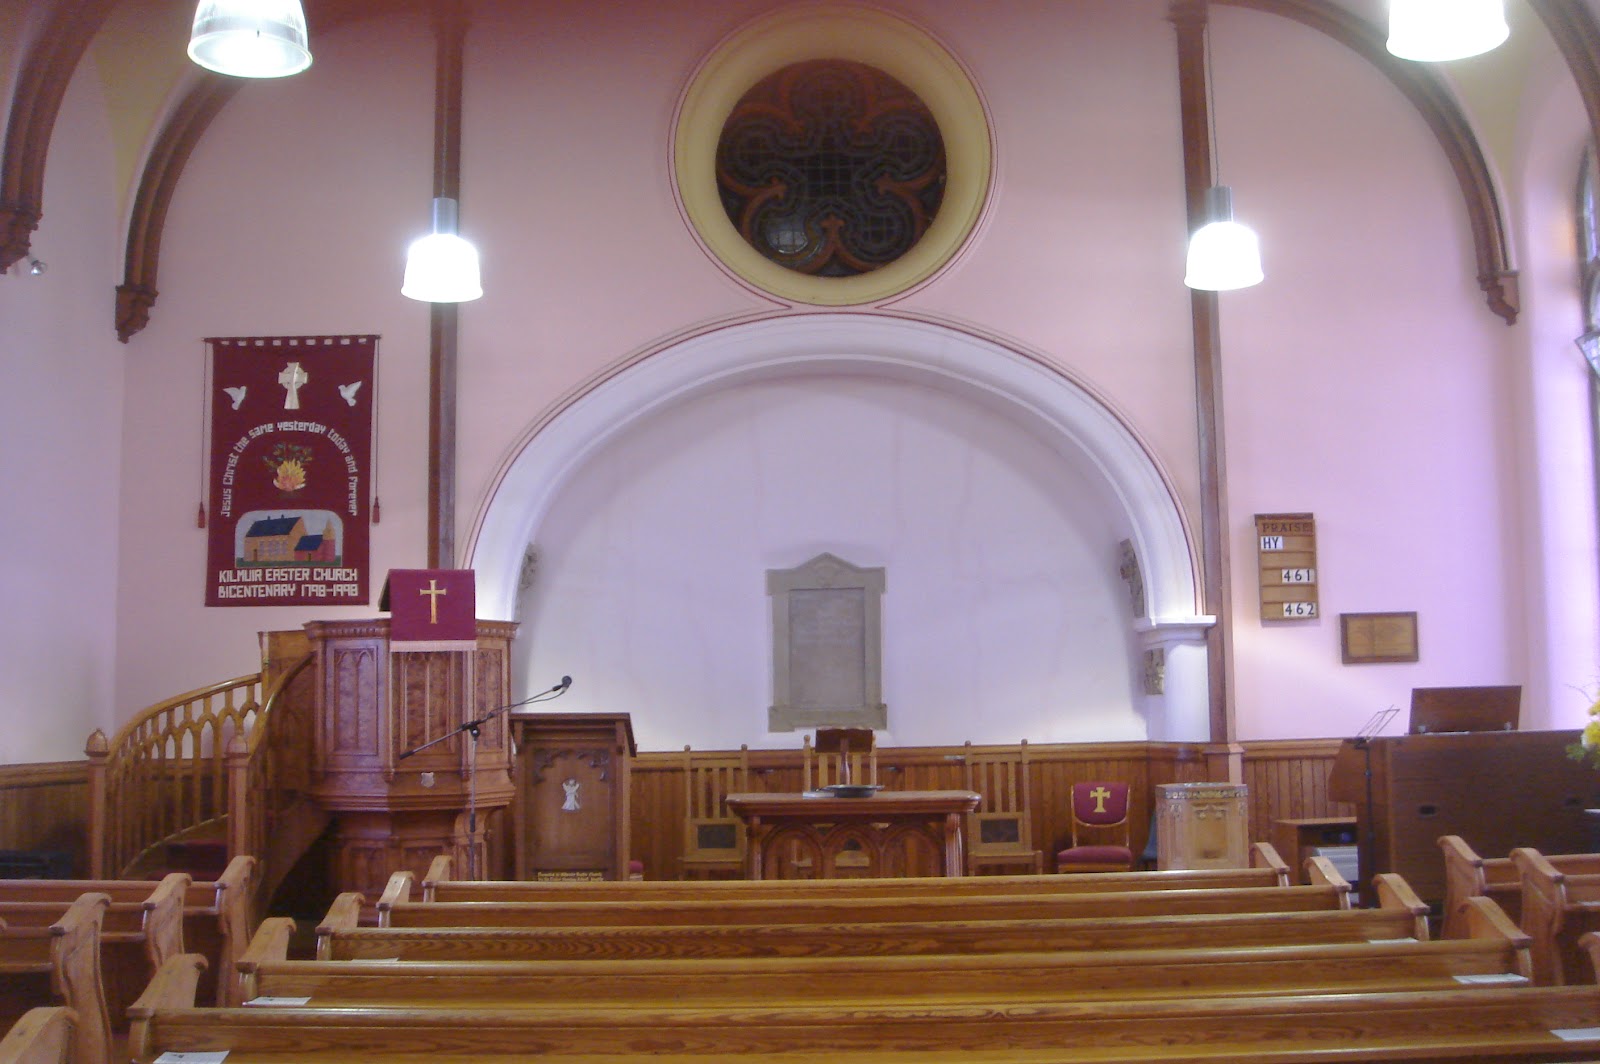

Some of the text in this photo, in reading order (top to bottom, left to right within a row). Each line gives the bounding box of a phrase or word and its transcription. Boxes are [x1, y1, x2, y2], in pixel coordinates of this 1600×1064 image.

[1263, 537, 1279, 549] HY
[219, 568, 357, 583] KILMUIR EASTER CHURCH
[1283, 570, 1311, 581] 461
[218, 583, 359, 598] BICENTENARY 1798-1998
[1285, 603, 1314, 615] 462
